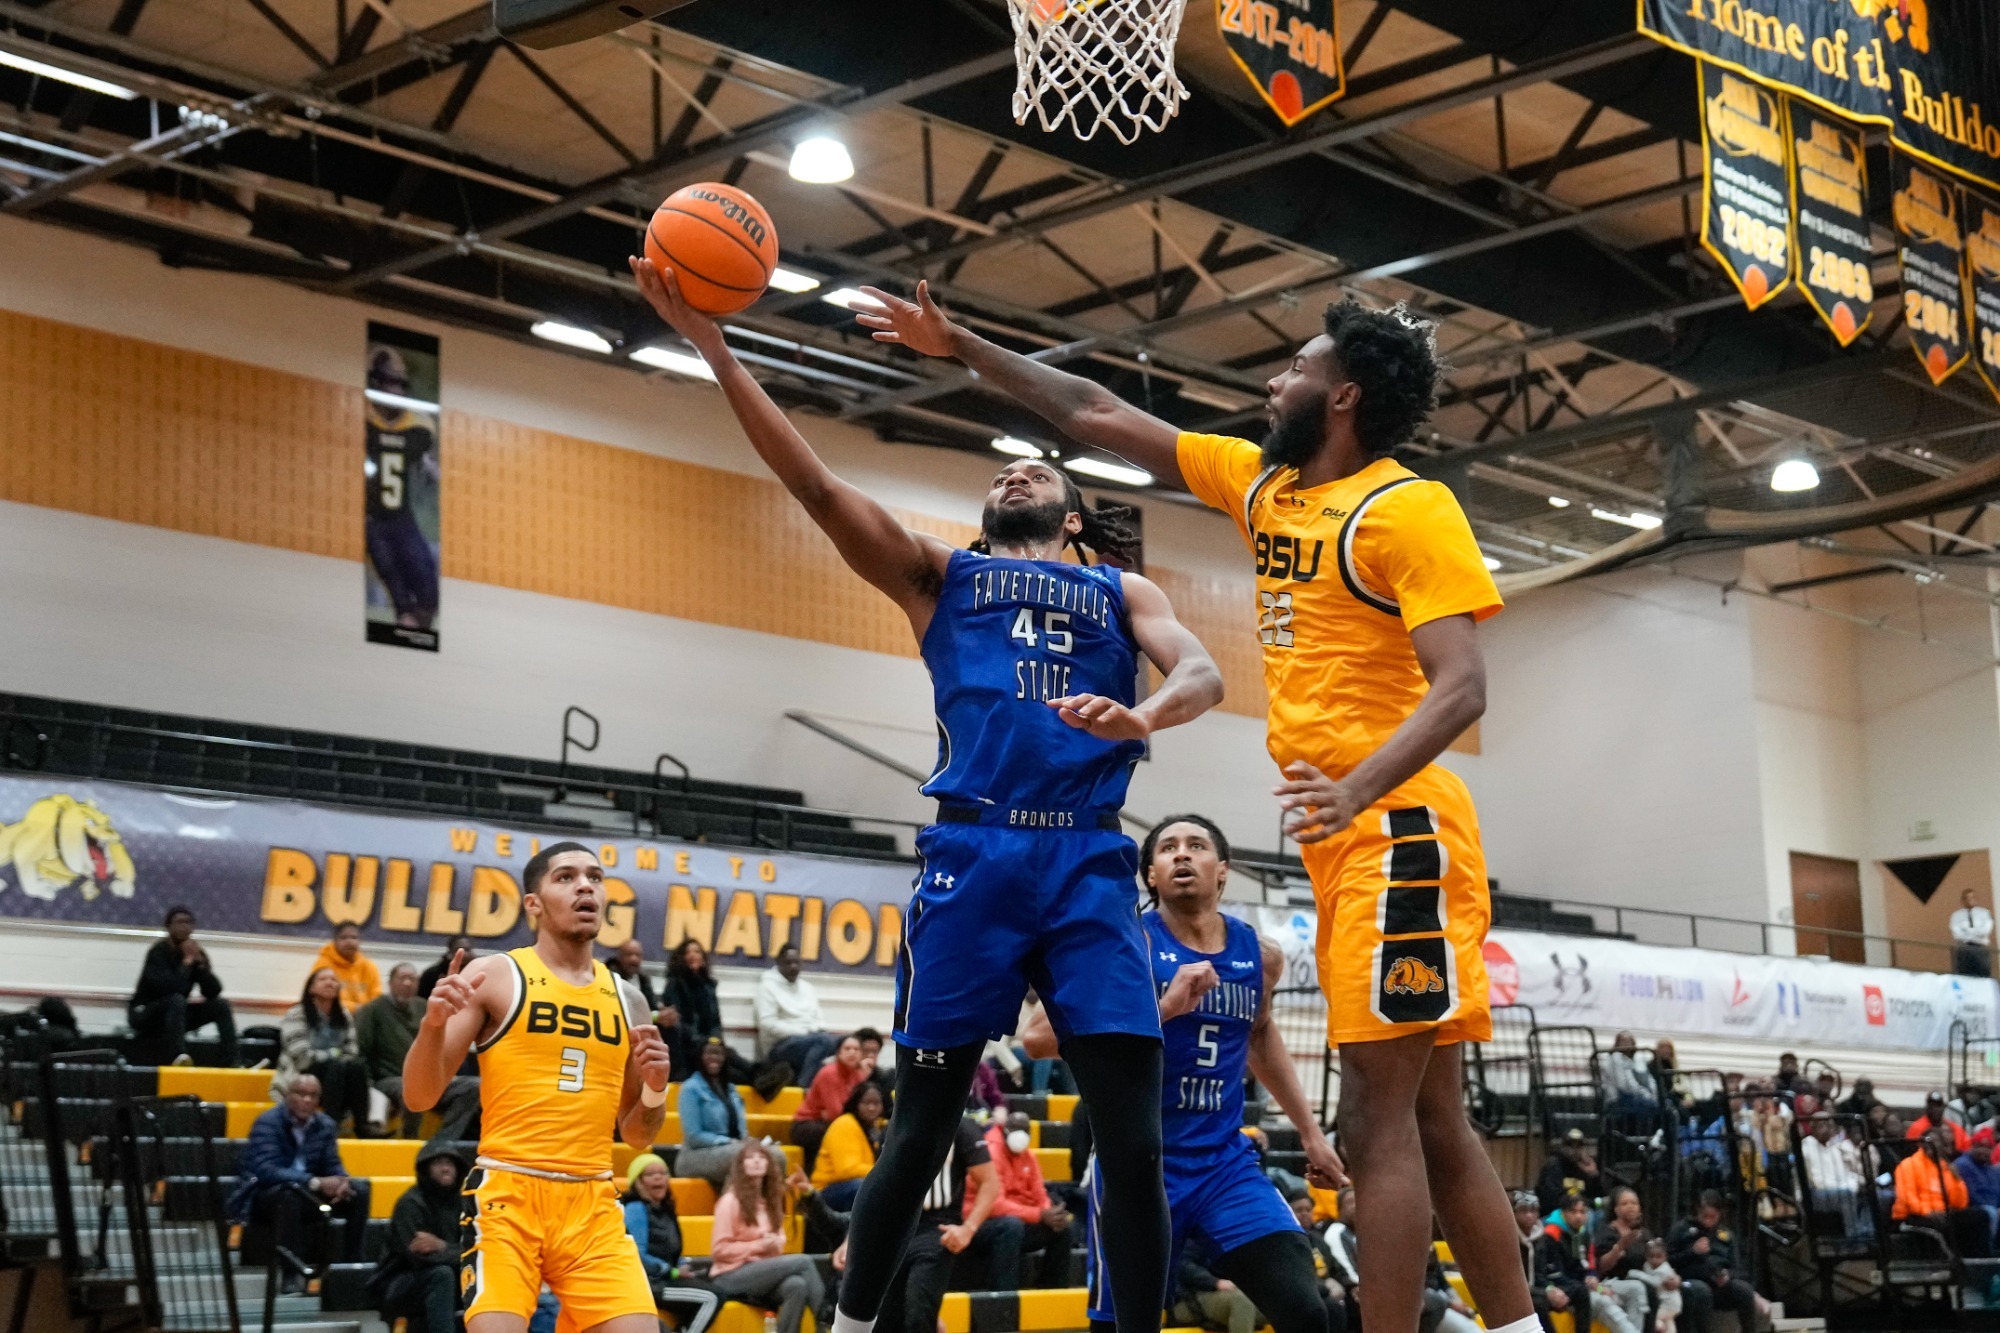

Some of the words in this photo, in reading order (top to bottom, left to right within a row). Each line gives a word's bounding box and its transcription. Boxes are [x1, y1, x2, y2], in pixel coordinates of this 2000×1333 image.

[1812, 29, 1849, 81] of
[690, 189, 766, 248] Wilson
[1719, 204, 1786, 269] 2002
[381, 452, 404, 510] 5
[1256, 531, 1324, 582] BSU
[974, 570, 1109, 629] FAYETTEVILLE
[1011, 608, 1074, 654] 45
[1016, 660, 1071, 702] STATE
[1010, 809, 1074, 827] BRONCOS
[451, 827, 690, 874] WELOME
[729, 857, 777, 882] TO
[260, 847, 637, 947] BULLDG
[527, 1001, 621, 1046] BSU
[1889, 998, 1934, 1018] TOYOTA
[558, 1047, 588, 1093] 3
[1196, 1024, 1220, 1068] 5
[1177, 1076, 1224, 1112] STATE
